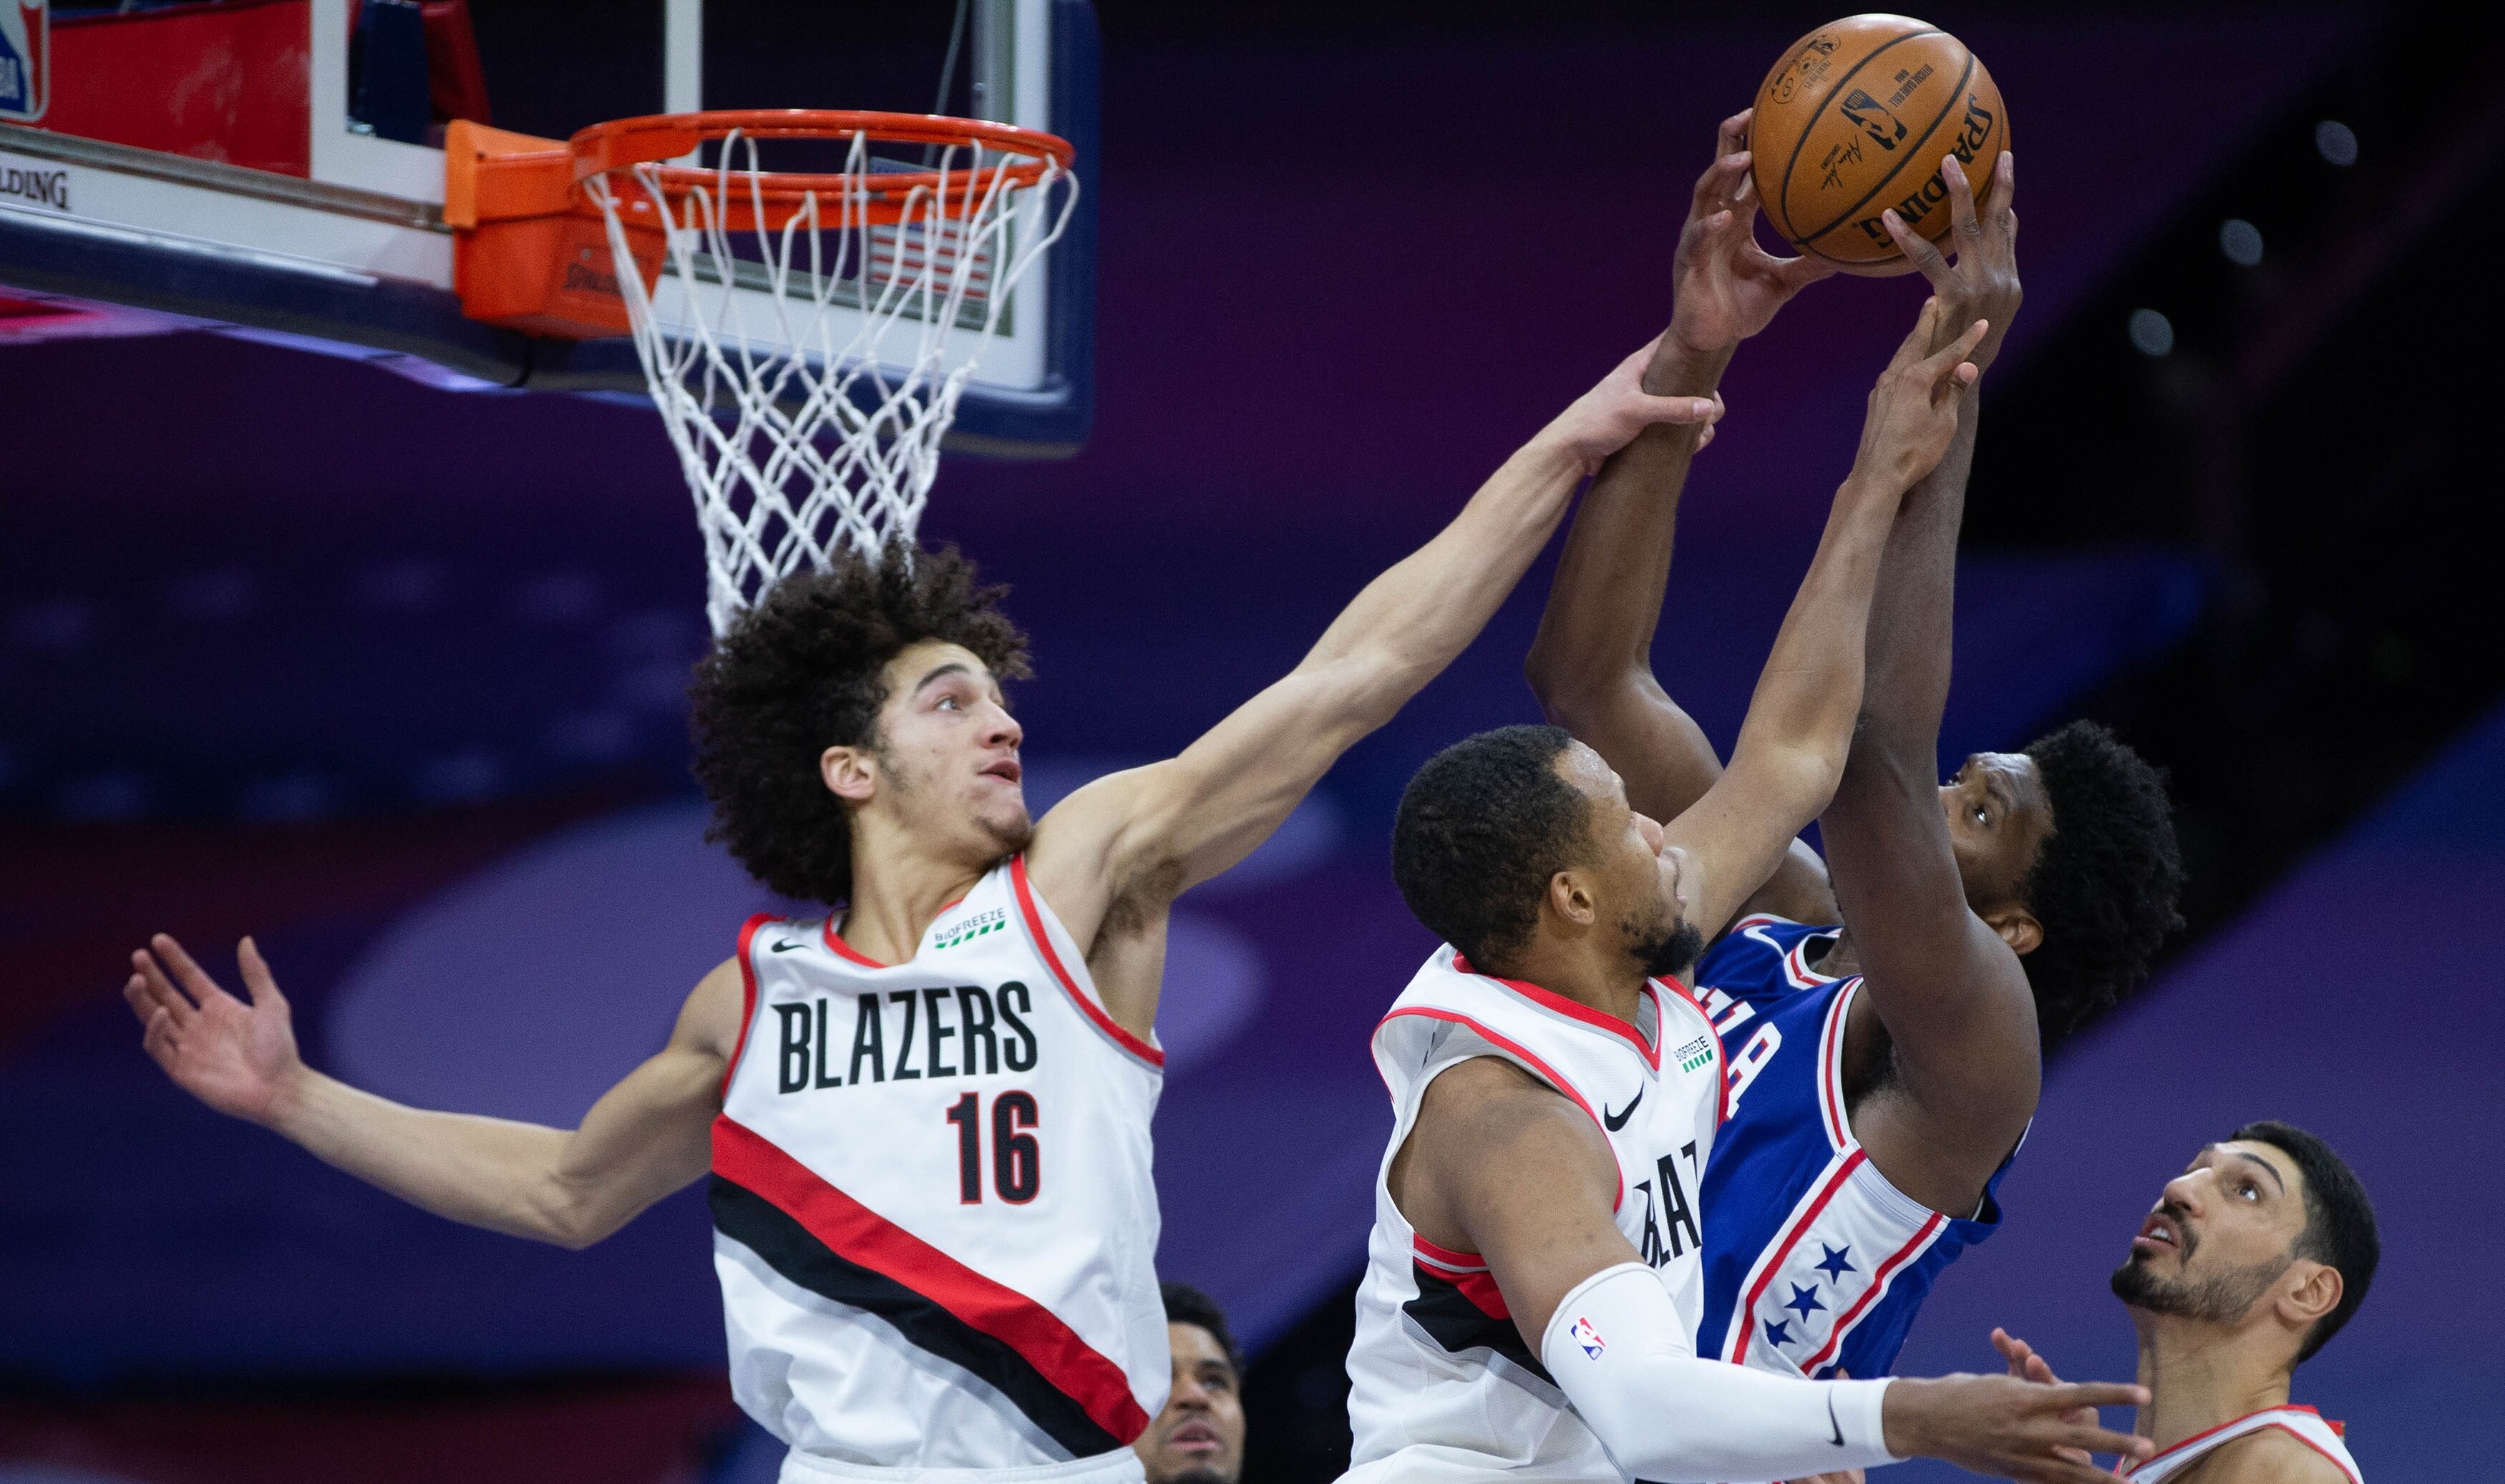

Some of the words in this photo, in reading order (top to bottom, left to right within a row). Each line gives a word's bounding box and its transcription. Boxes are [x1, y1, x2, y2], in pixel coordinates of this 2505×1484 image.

[1859, 93, 1993, 249] SPADING
[935, 907, 1006, 941] BIOFREEZE
[771, 981, 1039, 1094] BLAZERS
[1673, 1035, 1709, 1061] BIOFREEZE
[946, 1090, 1041, 1205] 16
